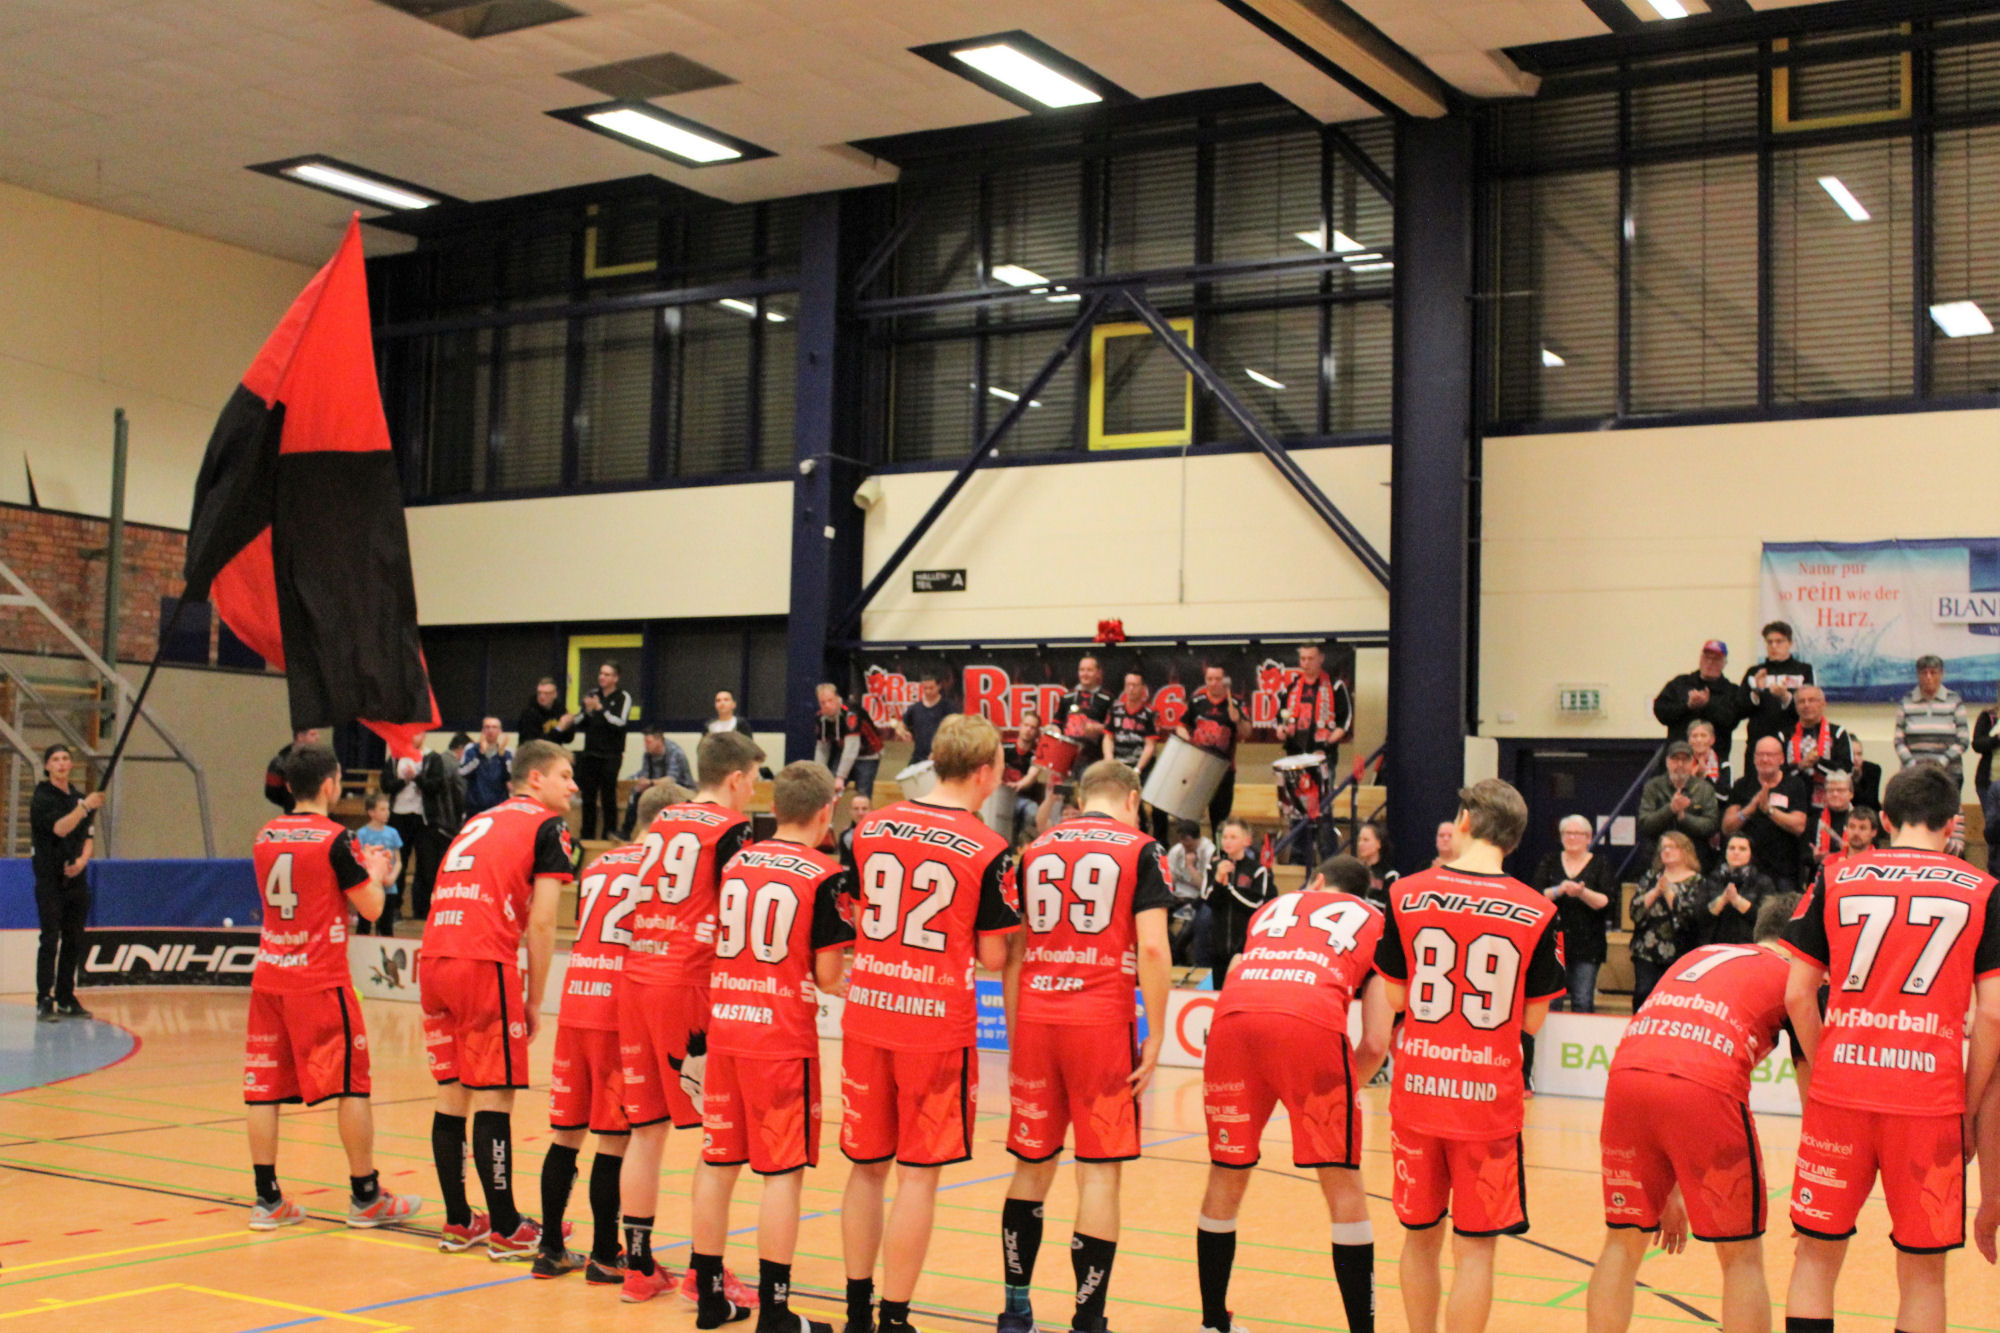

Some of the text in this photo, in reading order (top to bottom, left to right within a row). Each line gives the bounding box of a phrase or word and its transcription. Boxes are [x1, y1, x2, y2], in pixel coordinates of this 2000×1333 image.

[951, 572, 964, 587] A
[1799, 561, 1867, 578] Natur pur
[1797, 582, 1841, 602] rein
[1846, 587, 1871, 601] wie
[1874, 585, 1900, 601] der
[1817, 607, 1875, 628] Harz.
[443, 816, 494, 873] 2
[860, 819, 985, 859] UNIHOC
[265, 852, 299, 920] 4
[636, 831, 702, 905] 29
[1835, 863, 1983, 892] UNIHOC
[576, 872, 638, 946] 72
[860, 851, 959, 954] 92
[1025, 851, 1122, 936] 69
[1400, 889, 1545, 928] UNIHOC
[714, 877, 800, 965] 90
[1250, 892, 1371, 957] 44
[1674, 943, 1763, 983] 7
[1838, 894, 1972, 997] 77
[567, 979, 613, 998] ZILLING
[1240, 968, 1318, 986] MILDNER
[1408, 926, 1522, 1032] 89
[711, 1002, 774, 1025] KASTNER
[1823, 1007, 1955, 1040] MrFloorball.de
[1832, 1043, 1937, 1074] HELLMUND
[1403, 1072, 1499, 1103] GRANLUND
[492, 1138, 507, 1190] UNIHOC
[1003, 1227, 1024, 1275] UNIHOC
[1075, 1265, 1105, 1305] UNIHOC
